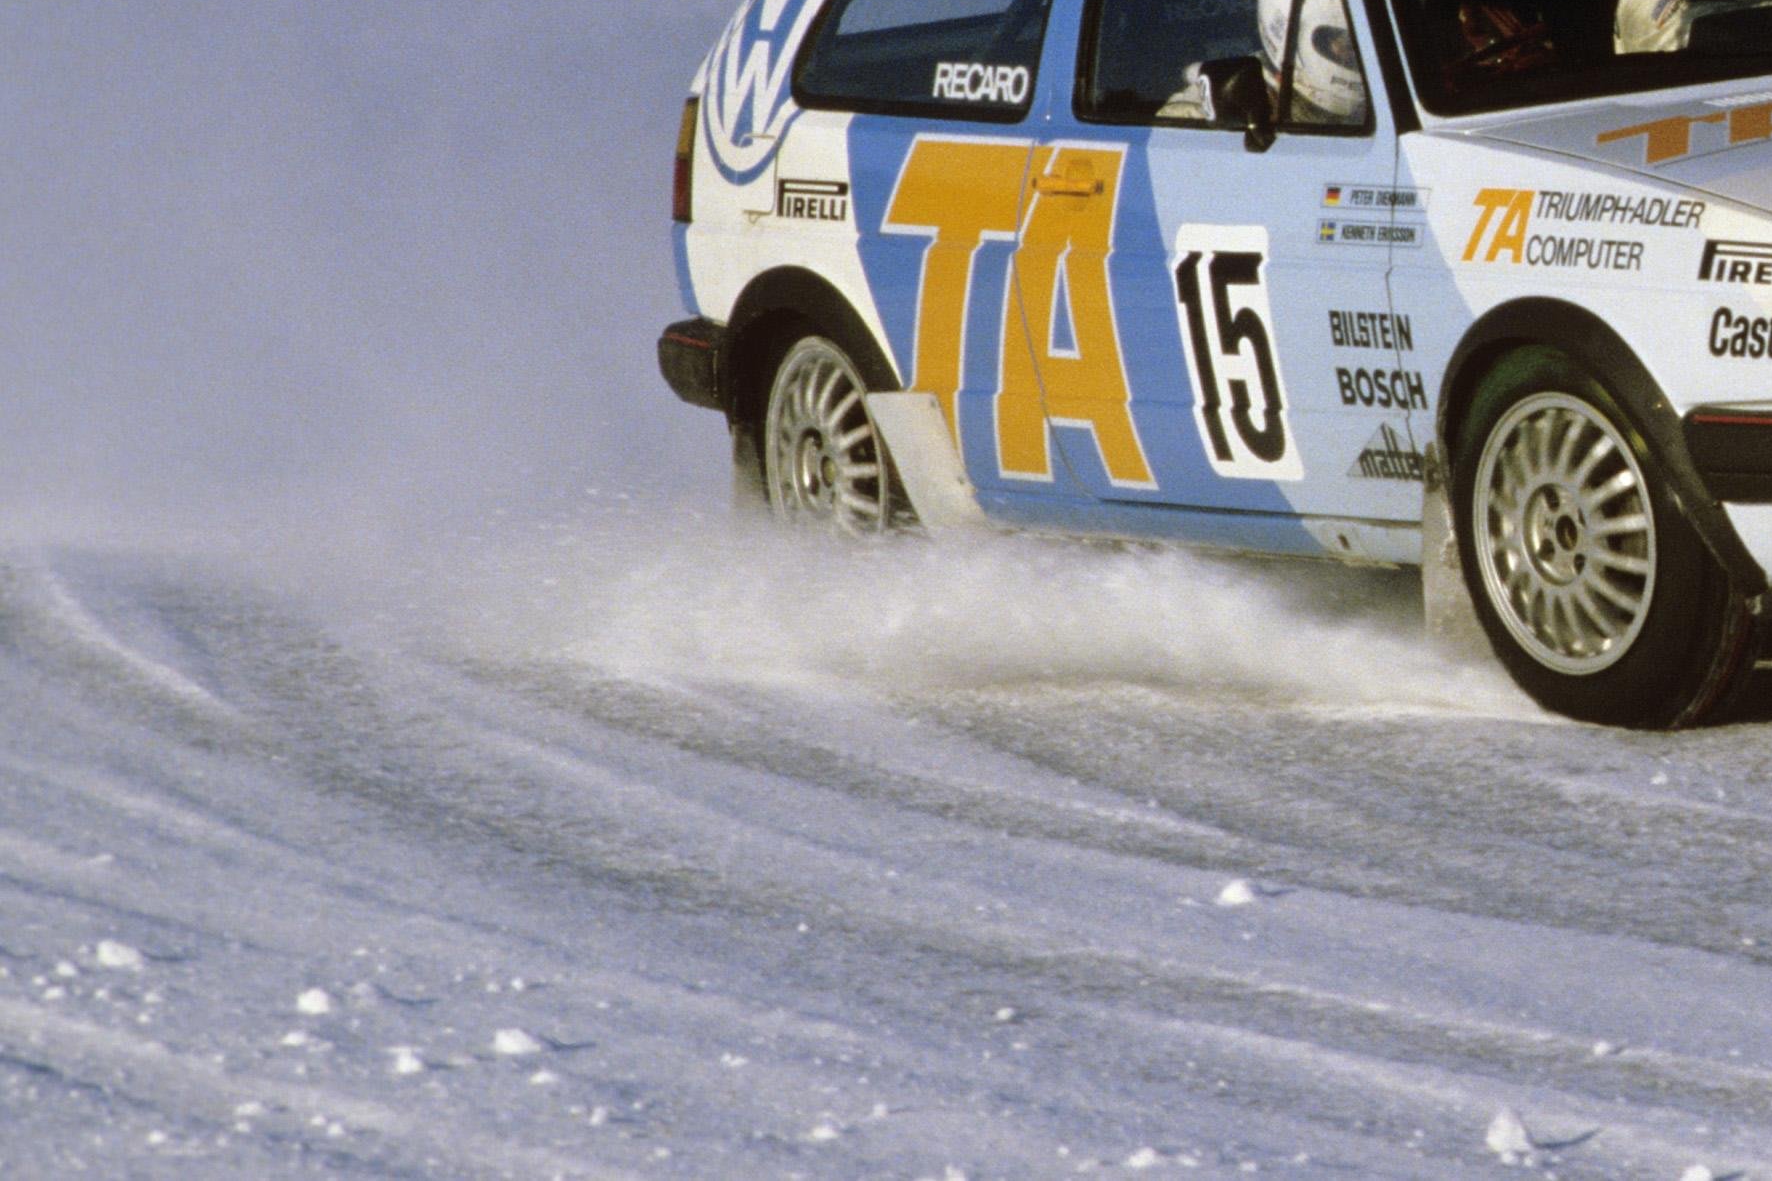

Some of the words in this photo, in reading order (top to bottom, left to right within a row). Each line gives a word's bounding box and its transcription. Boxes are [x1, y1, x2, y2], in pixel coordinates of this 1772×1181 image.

[932, 62, 1030, 104] RECARO
[777, 178, 849, 222] PIRELLI
[1461, 187, 1536, 264] TA
[1535, 190, 1706, 231] TRIUMPH-ADLER
[1525, 234, 1646, 272] COMPUTER
[880, 132, 1160, 491] TA
[1328, 309, 1414, 352] BILSTEIN
[1175, 250, 1286, 463] 15
[1336, 367, 1429, 411] BOSCH
